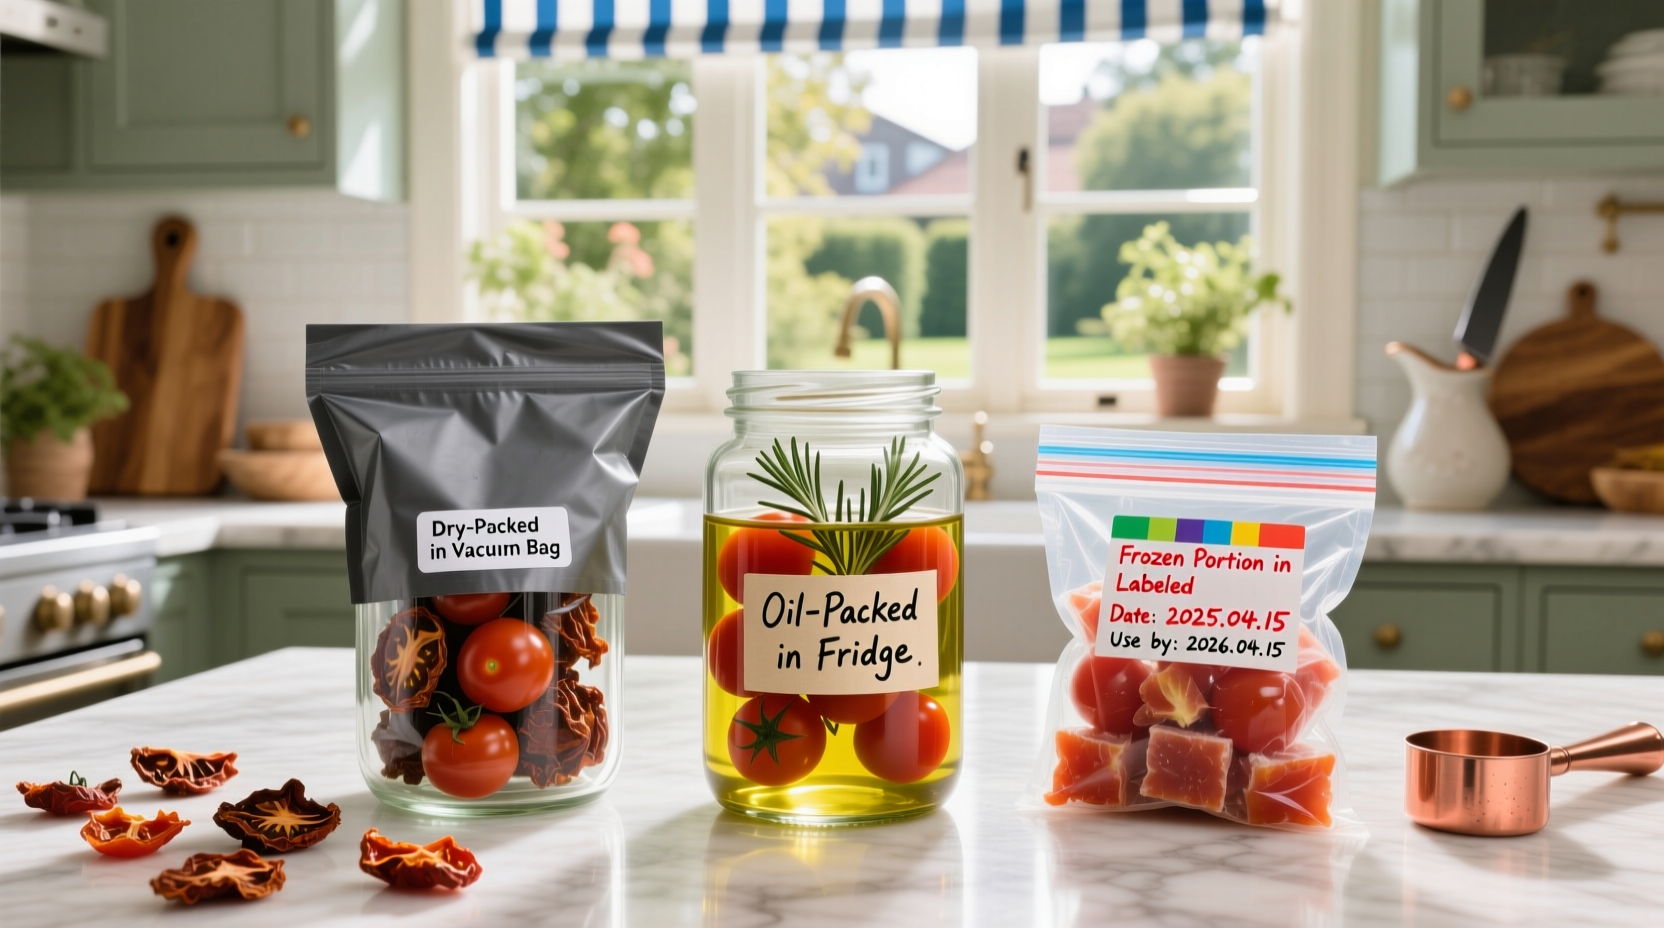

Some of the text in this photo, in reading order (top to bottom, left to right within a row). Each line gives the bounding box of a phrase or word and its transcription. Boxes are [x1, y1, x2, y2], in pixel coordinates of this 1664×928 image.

[432, 516, 539, 541] Dry-Packed
[430, 543, 447, 560] in
[527, 539, 560, 560] Bag
[1119, 545, 1291, 573] Frozen Portion in
[1116, 573, 1195, 595] Labeled
[762, 587, 919, 629] Oil-Packed
[1109, 603, 1291, 632] Date: 2025.04.15
[777, 634, 922, 682] in Fridge.
[1110, 631, 1286, 658] Use by: 2026.04.15
